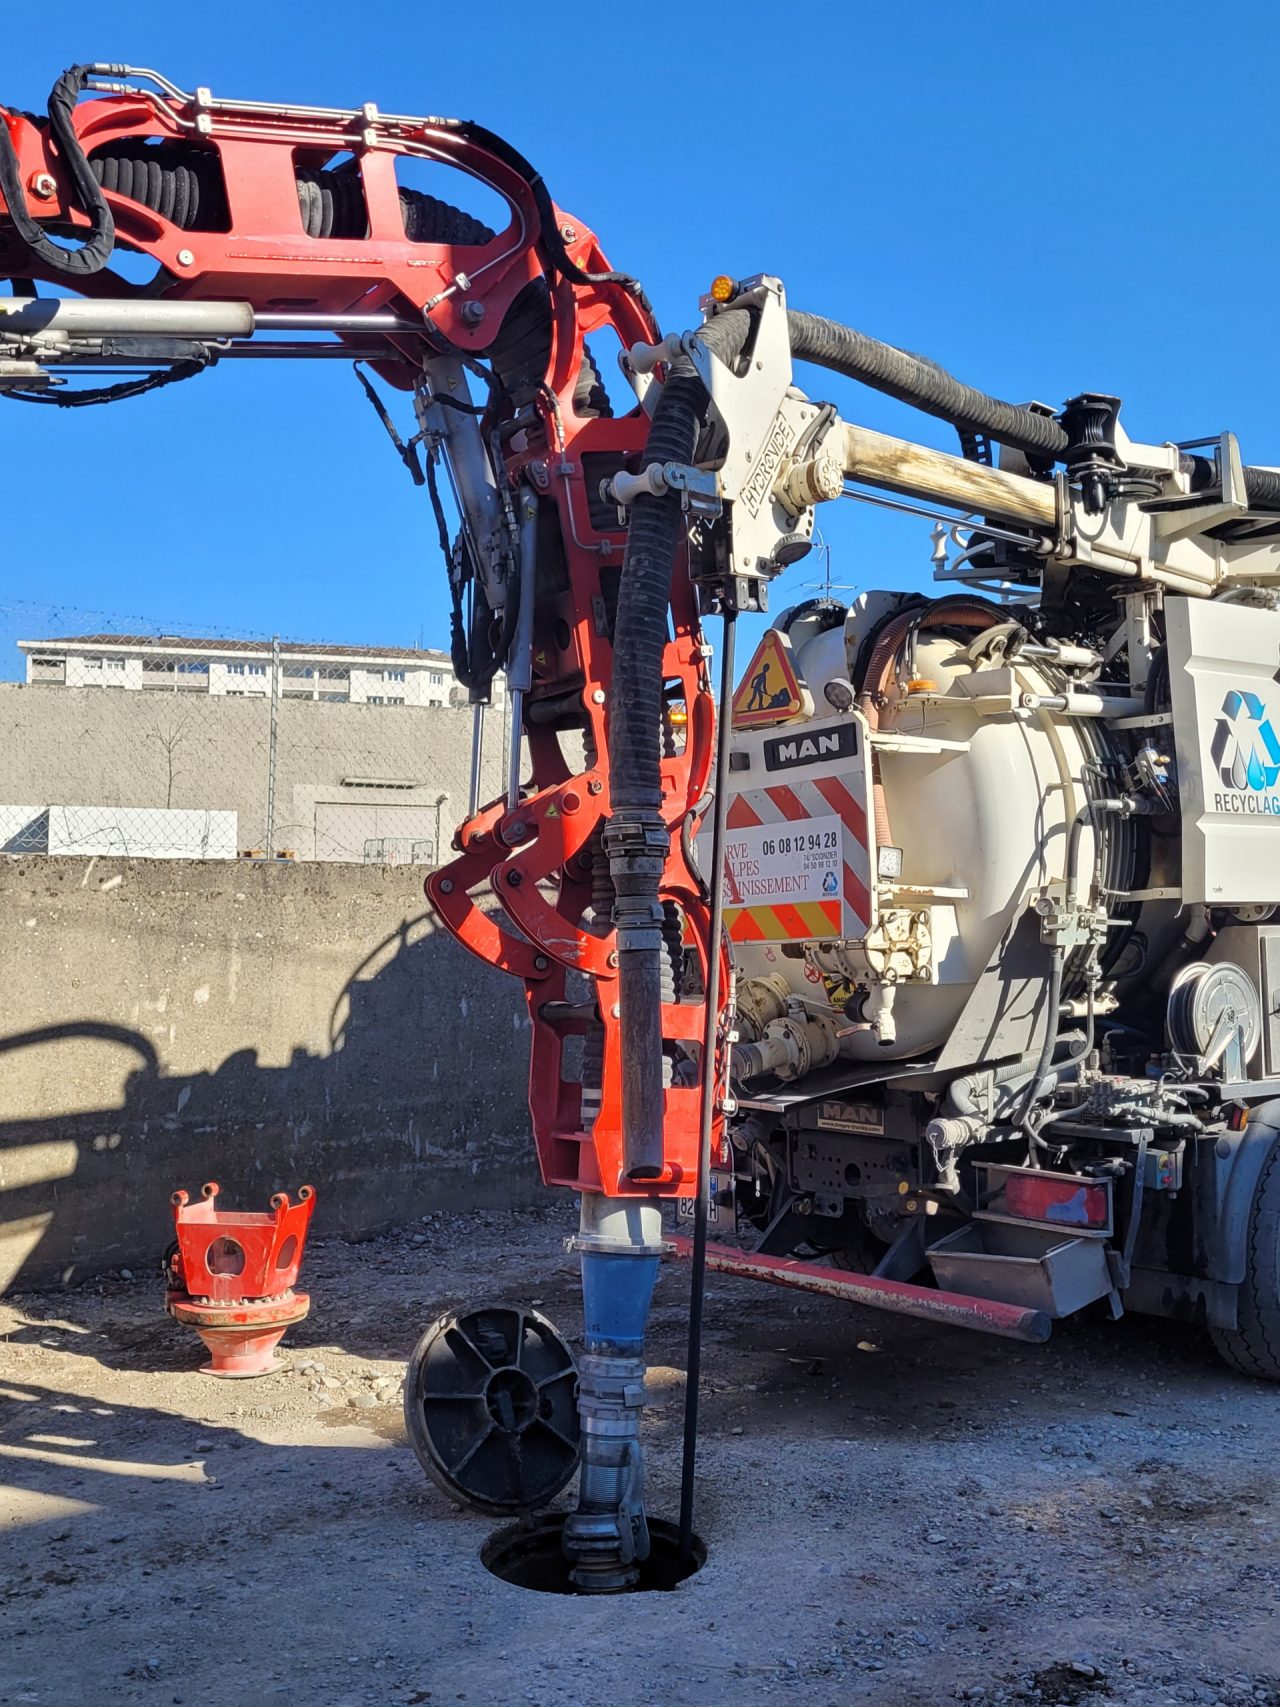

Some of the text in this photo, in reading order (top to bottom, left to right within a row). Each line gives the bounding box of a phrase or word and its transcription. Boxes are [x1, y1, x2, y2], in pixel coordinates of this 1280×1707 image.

[745, 421, 790, 509] HYDROVIDE
[778, 733, 840, 762] MAN
[1214, 792, 1280, 815] RECYCLAG
[762, 831, 838, 856] 06 08 12 94 28
[803, 862, 810, 870] 04
[810, 861, 818, 870] 50
[822, 1103, 878, 1124] MAN
